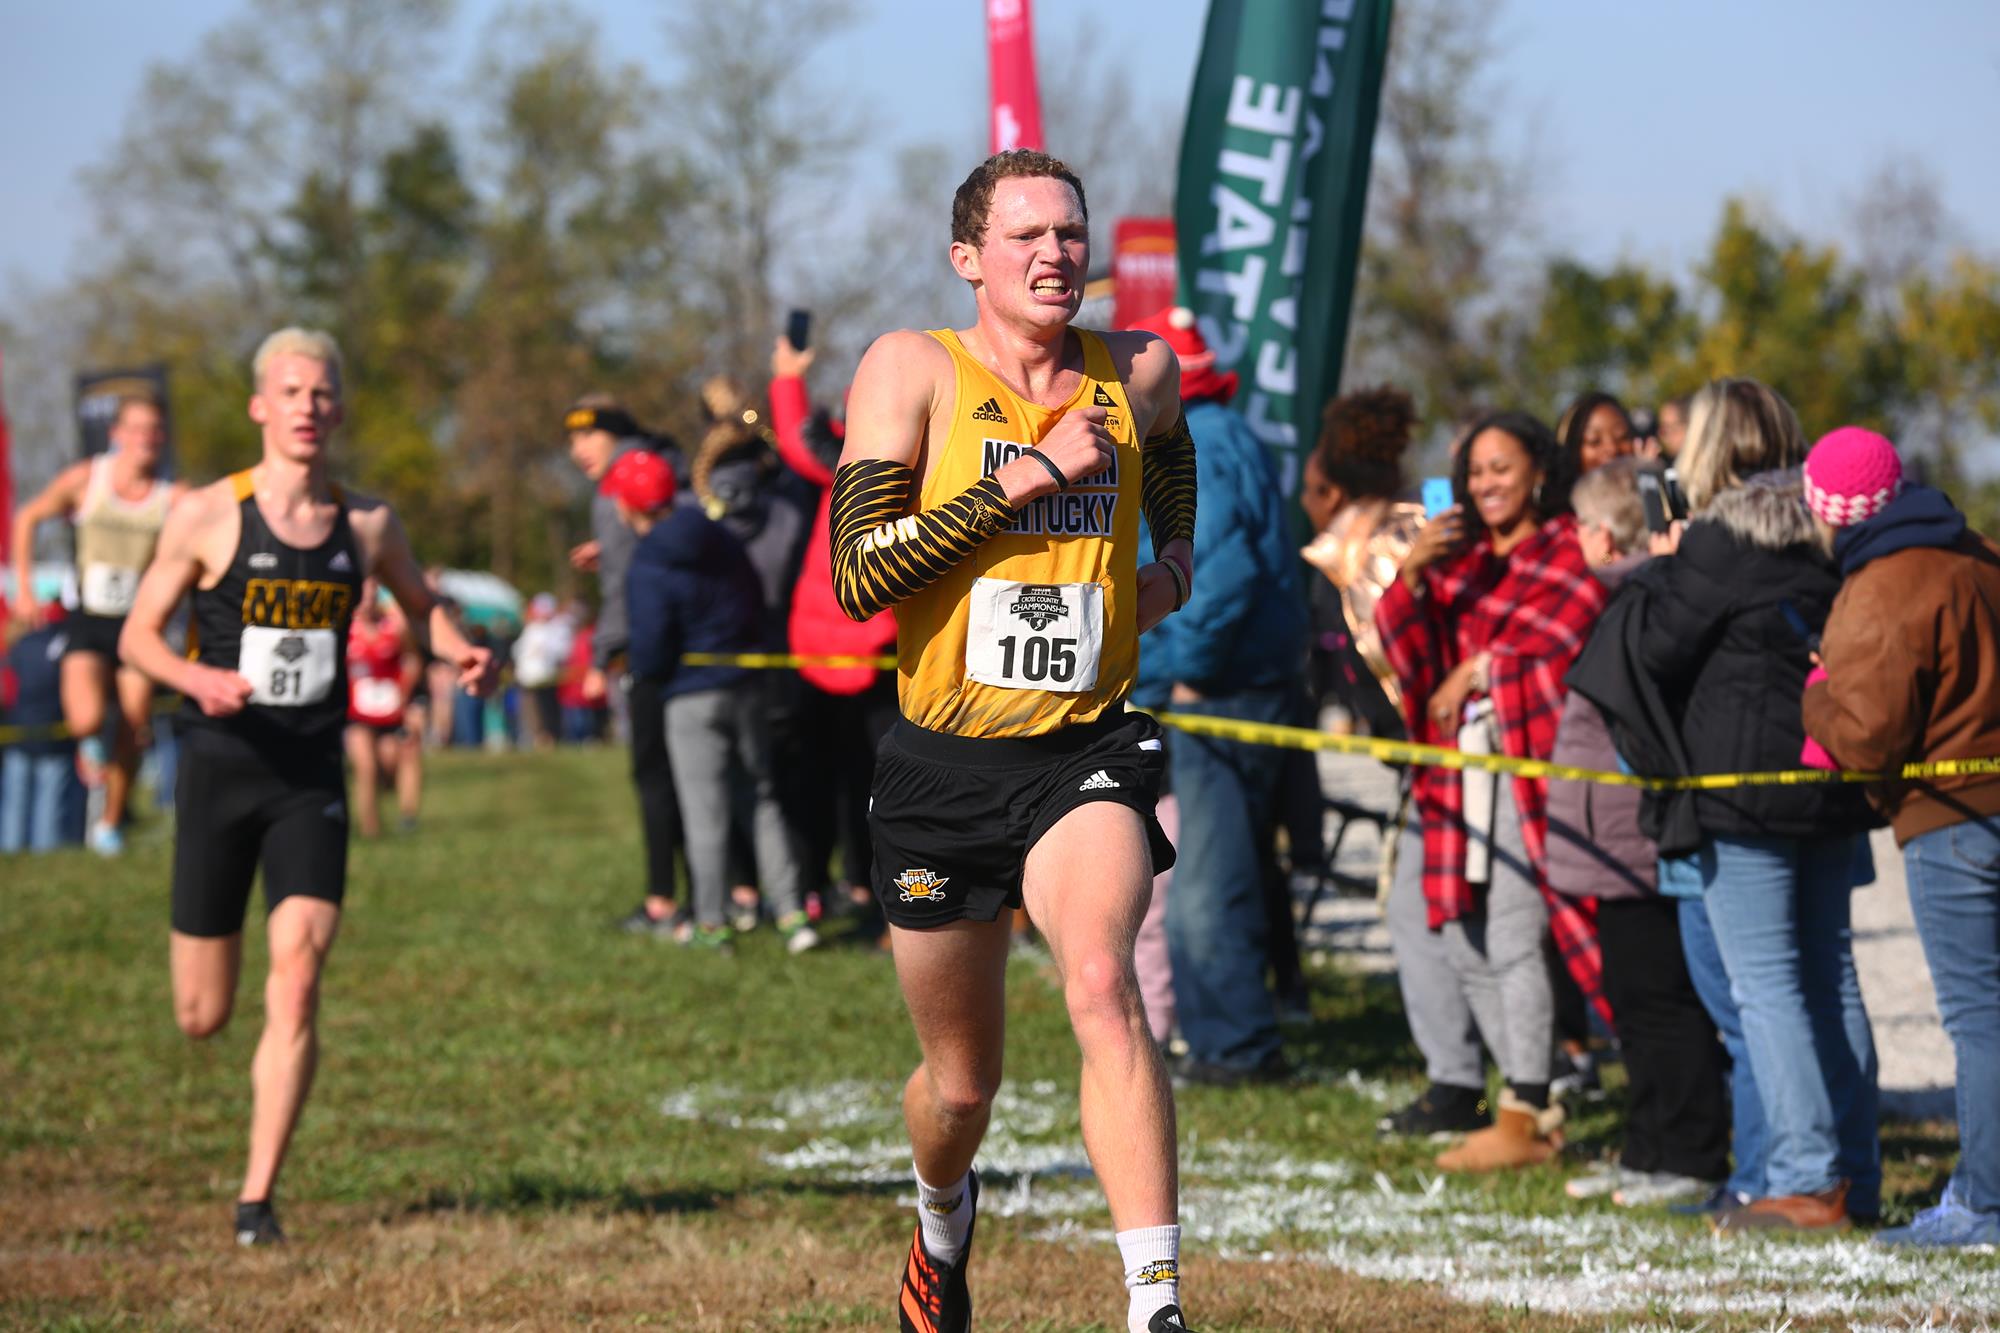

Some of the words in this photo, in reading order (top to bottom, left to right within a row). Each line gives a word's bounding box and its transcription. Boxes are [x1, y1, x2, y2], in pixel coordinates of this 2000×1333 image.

[972, 411, 1008, 424] adidas
[1036, 596, 1059, 604] COUNTRY
[1011, 602, 1068, 614] CHAMPIONSHIP
[998, 635, 1077, 682] 105
[271, 669, 303, 695] 81
[1079, 780, 1120, 791] adidas
